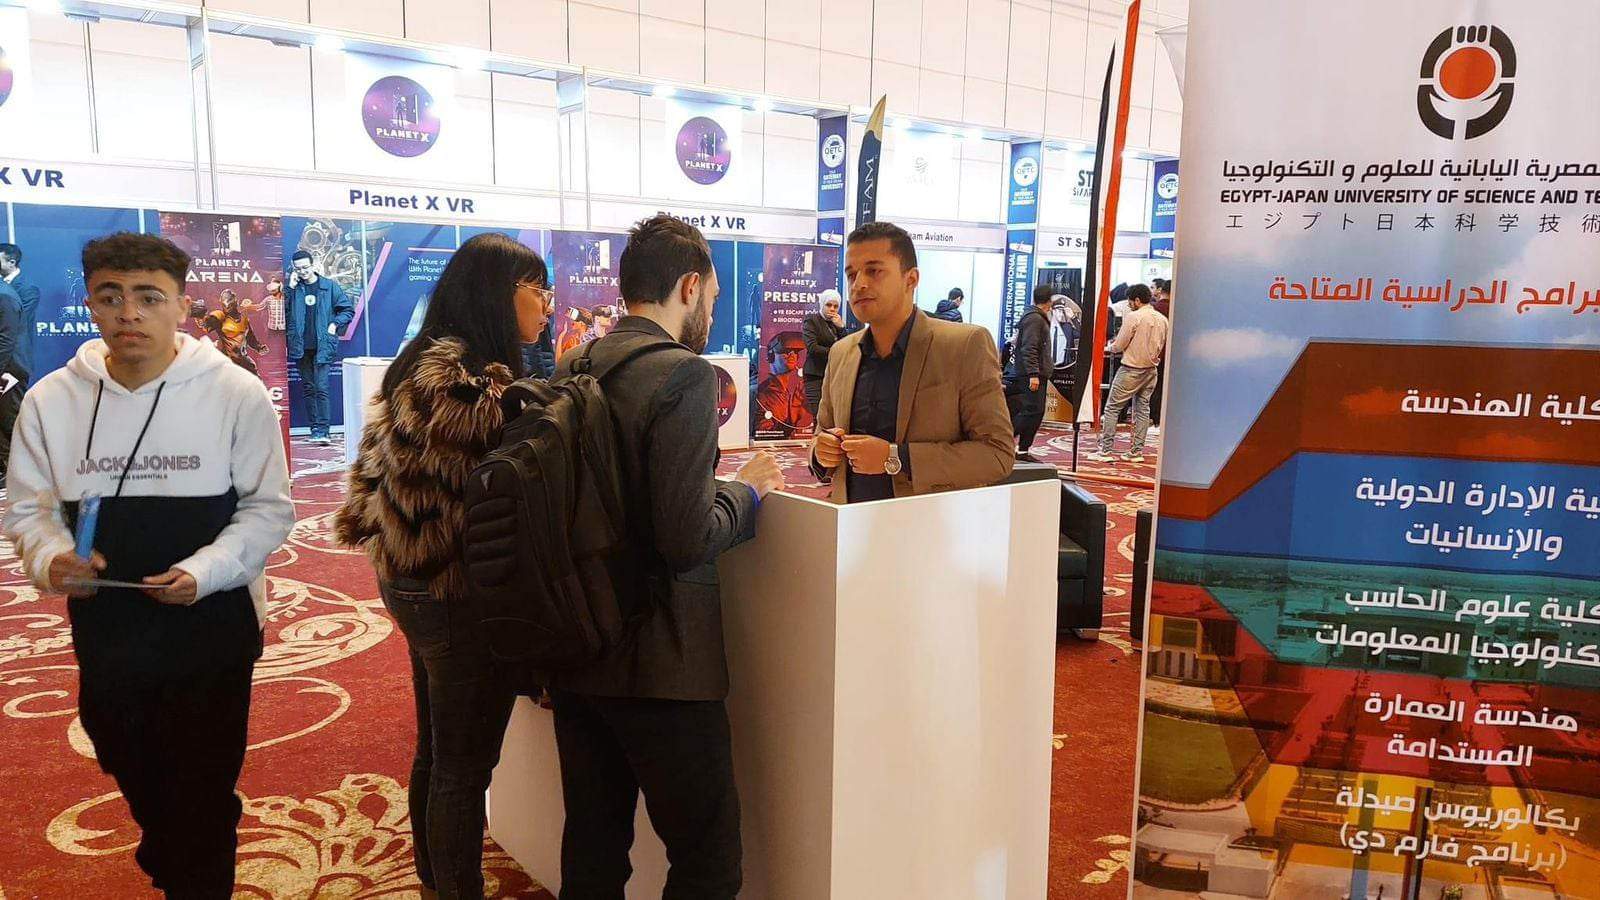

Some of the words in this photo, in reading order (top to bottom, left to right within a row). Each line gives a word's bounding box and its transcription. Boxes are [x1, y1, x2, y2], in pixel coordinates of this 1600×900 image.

[376, 127, 420, 139] PLANET
[21, 168, 65, 188] VR
[1223, 160, 1335, 183] التكنولوجيا
[1342, 164, 1355, 183] و
[1361, 159, 1433, 183] للعلوم
[1439, 159, 1519, 182] اليابانية
[349, 189, 418, 209] Planet
[426, 195, 439, 211] X
[446, 197, 474, 213] VR
[1220, 189, 1329, 203] EGYPT-JAPAN
[1334, 189, 1432, 203] UNIVERSITY
[1437, 190, 1459, 203] OF
[1463, 190, 1536, 204] SCIENCE
[1540, 190, 1578, 204] AND
[711, 215, 721, 228] X
[726, 216, 746, 230] VR
[1057, 236, 1073, 247] ST
[185, 270, 264, 283] ARENA
[195, 258, 239, 267] PLANET
[241, 259, 251, 269] X
[569, 275, 609, 284] PLANET
[610, 277, 619, 287] X
[1006, 253, 1016, 318] INTERNATIONAL
[1269, 276, 1372, 301] المتاحة
[1382, 279, 1507, 312] الدراسية
[1401, 389, 1532, 418] الهندسة
[1355, 477, 1455, 509] الدولية
[1464, 482, 1555, 517] الإدارة
[1405, 523, 1563, 561] والإنسانيات
[1344, 587, 1447, 613] الحاسب
[1455, 595, 1531, 624] علوم
[1315, 624, 1461, 655] المعلومات
[1364, 692, 1465, 723] العمارة
[1474, 703, 1578, 732] هندسة
[1386, 733, 1533, 767] المستدامة
[1336, 785, 1415, 815] صيدلة
[1423, 801, 1581, 837] بكالوريوس
[1393, 833, 1459, 860] فارم
